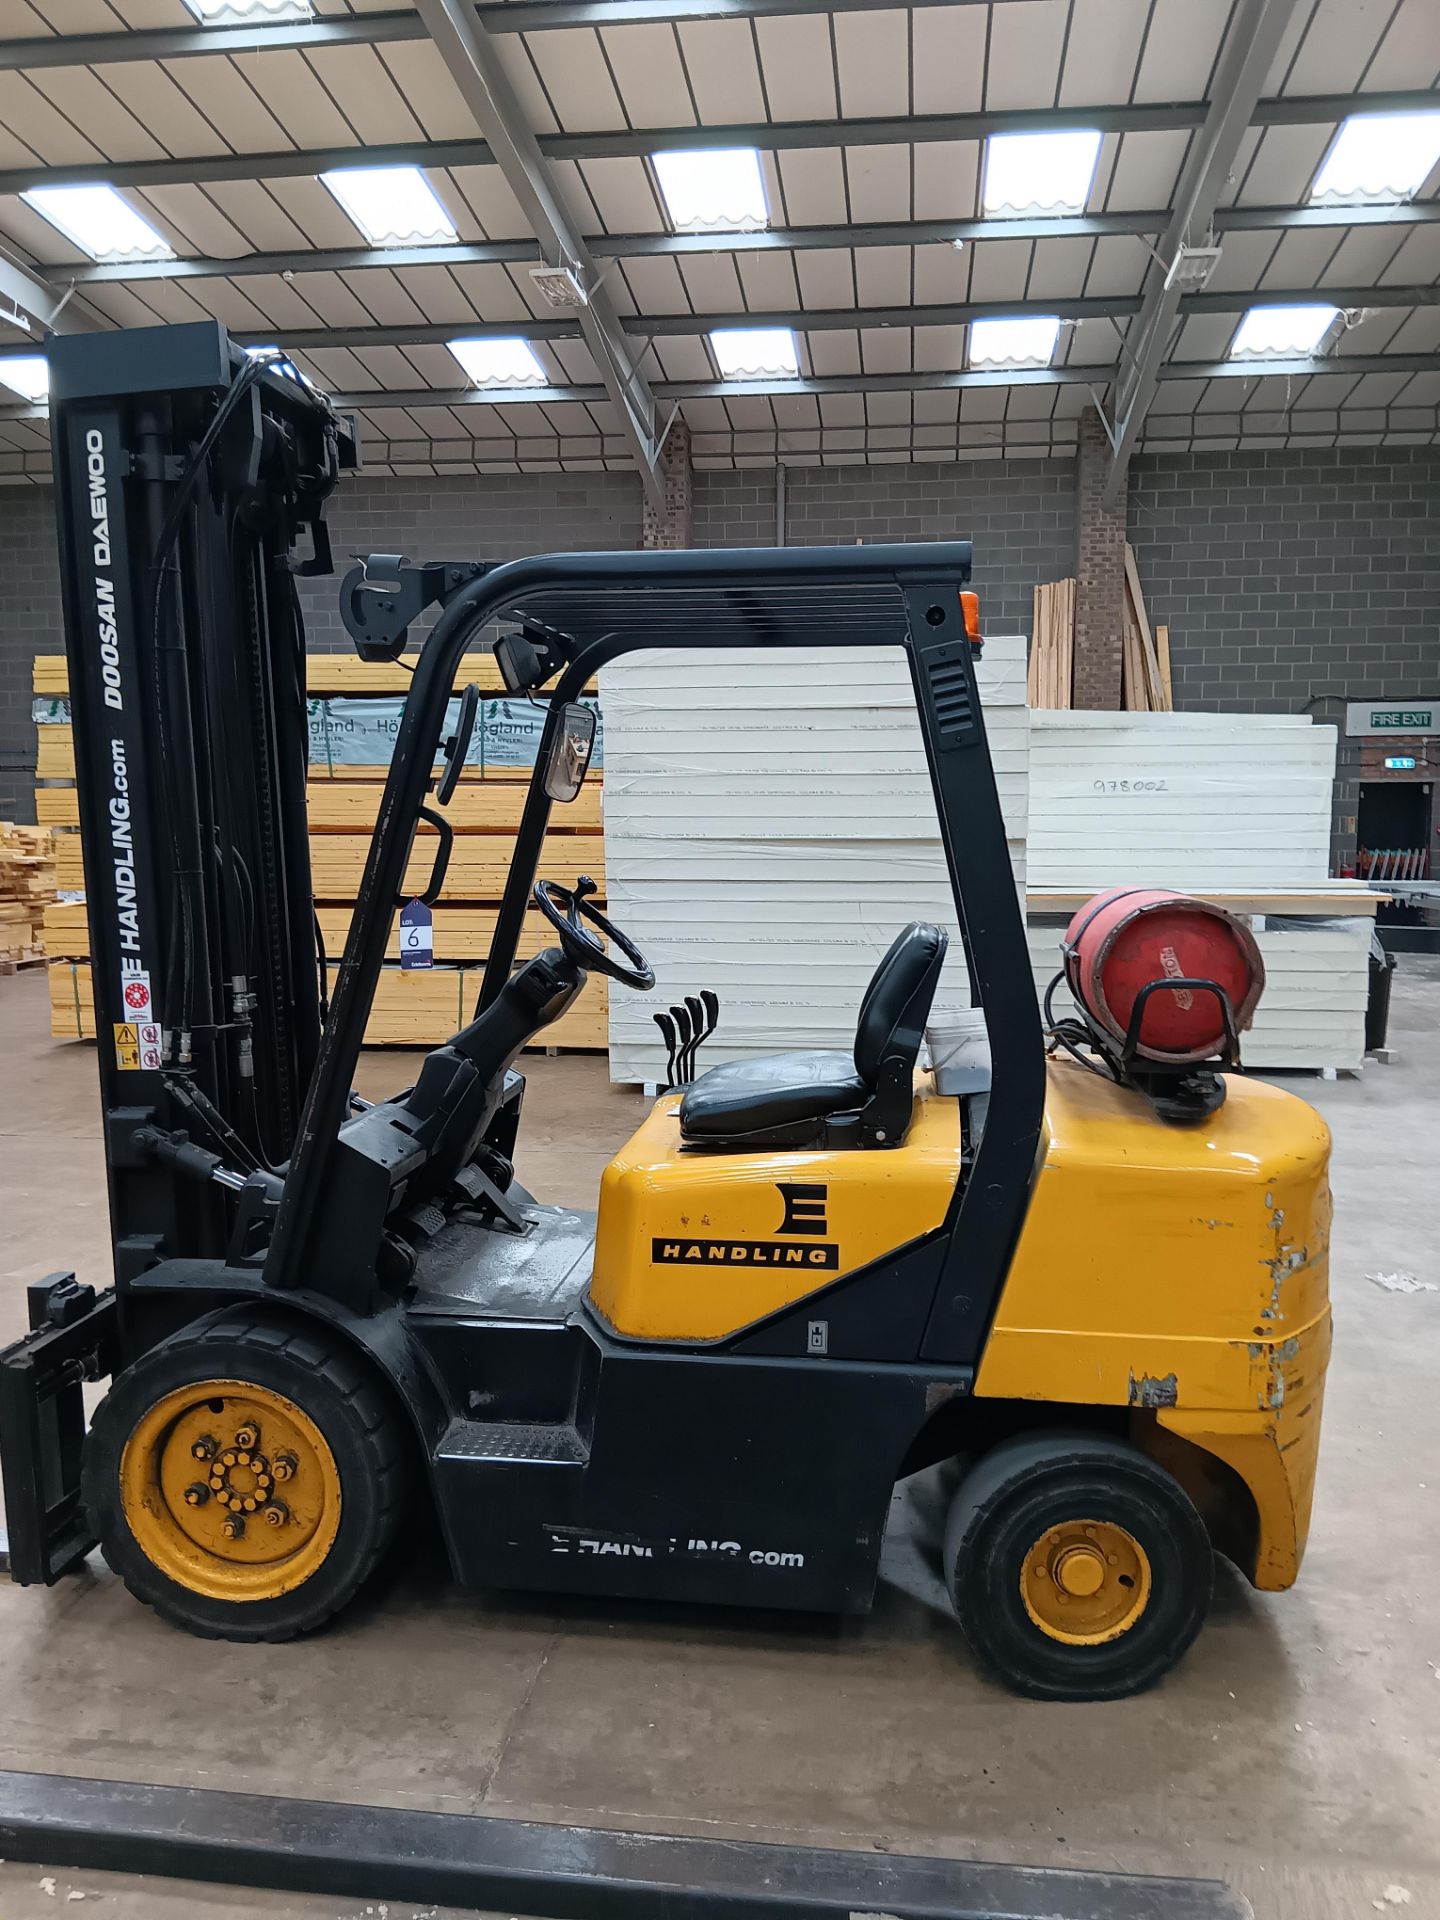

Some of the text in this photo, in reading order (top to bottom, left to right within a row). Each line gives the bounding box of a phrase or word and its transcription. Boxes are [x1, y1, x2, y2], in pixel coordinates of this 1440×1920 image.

[86, 429, 123, 710] DOOSAN DAEWOO
[1372, 713, 1430, 726] FIRE EXIT
[1093, 780, 1169, 792] 978002
[109, 739, 141, 951] HANDLING.com
[408, 928, 419, 947] 6
[773, 1183, 828, 1236] E
[663, 1244, 828, 1264] HANDLING
